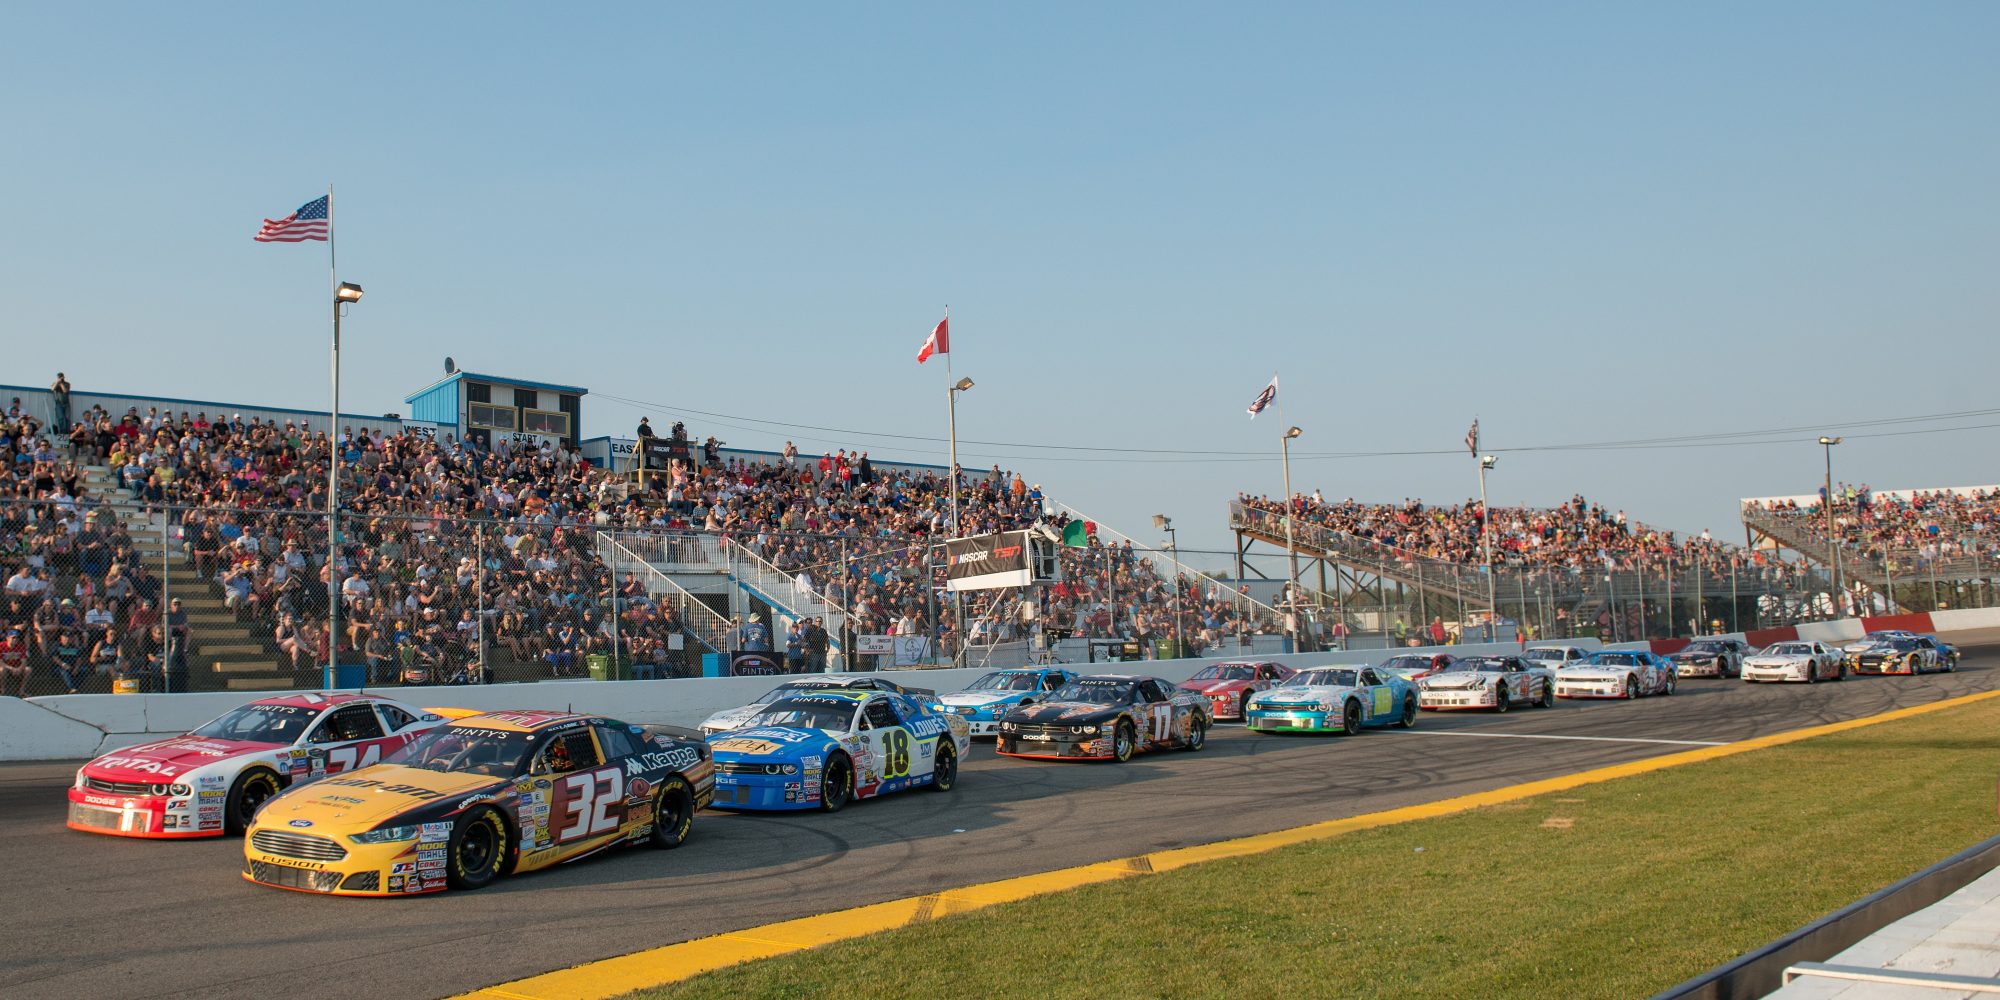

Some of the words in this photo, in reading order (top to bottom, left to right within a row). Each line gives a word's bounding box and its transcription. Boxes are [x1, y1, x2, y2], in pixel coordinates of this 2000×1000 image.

[404, 425, 437, 437] WEST
[513, 433, 537, 442] START
[959, 551, 988, 564] NASCAR
[993, 545, 1022, 559] TSN
[1926, 650, 1937, 667] 27
[251, 704, 298, 714] PINTY'S
[907, 716, 948, 737] LOWE'S
[1154, 705, 1171, 741] 17
[450, 727, 509, 739] PINTY'S
[642, 747, 699, 770] Kappa
[881, 729, 910, 778] 18
[94, 756, 177, 777] TOTAL
[85, 796, 116, 805] DODGE
[168, 801, 186, 809] JE
[459, 794, 496, 809] GOODYEAR
[561, 767, 623, 842] 32
[424, 823, 444, 831] Mobil
[262, 855, 325, 869] FUSION
[419, 851, 447, 859] MAHLE
[393, 863, 414, 874] JE
